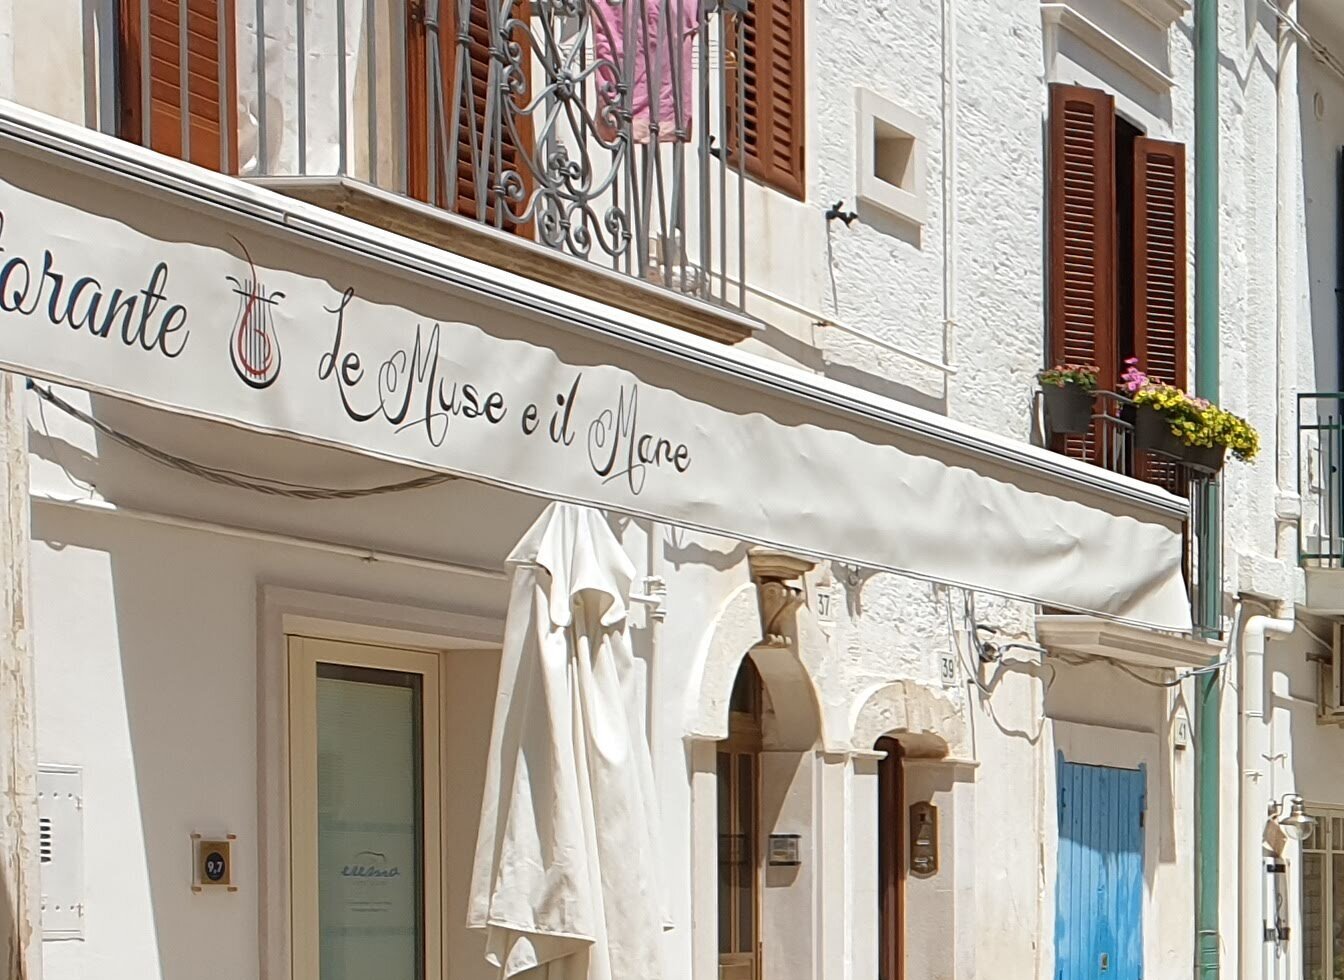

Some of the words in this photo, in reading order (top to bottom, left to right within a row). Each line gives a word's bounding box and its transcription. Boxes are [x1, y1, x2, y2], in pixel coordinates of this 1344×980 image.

[0, 211, 190, 358] orante
[319, 287, 384, 422] Le
[379, 323, 507, 446] Muse
[522, 402, 541, 436] e
[549, 372, 582, 446] il
[818, 594, 830, 616] 37
[942, 657, 954, 678] 39
[1178, 722, 1187, 741] 41
